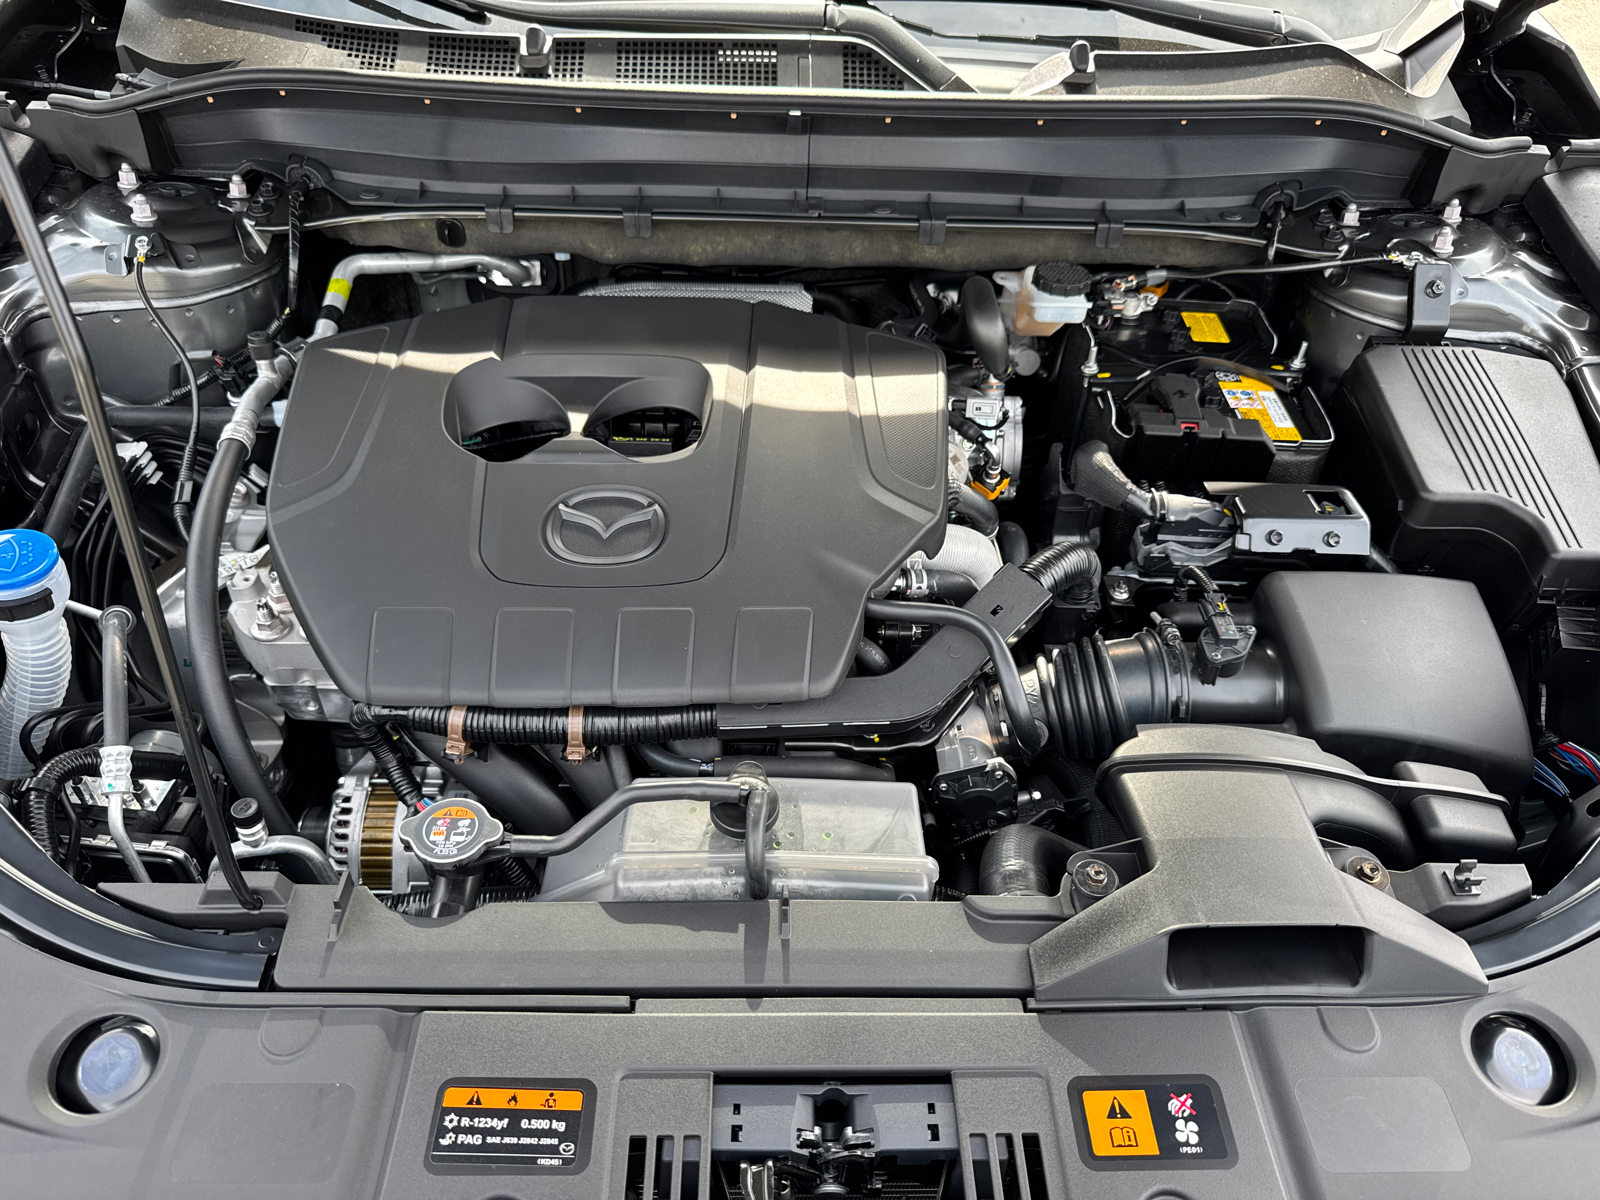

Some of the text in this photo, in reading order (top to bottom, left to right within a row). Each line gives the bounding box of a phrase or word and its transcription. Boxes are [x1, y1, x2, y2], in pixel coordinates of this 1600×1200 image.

[460, 1117, 566, 1132] R-1234yf 0.500 kg
[457, 1133, 483, 1145] PAG
[502, 1136, 518, 1144] J639
[518, 1137, 539, 1145] J2842
